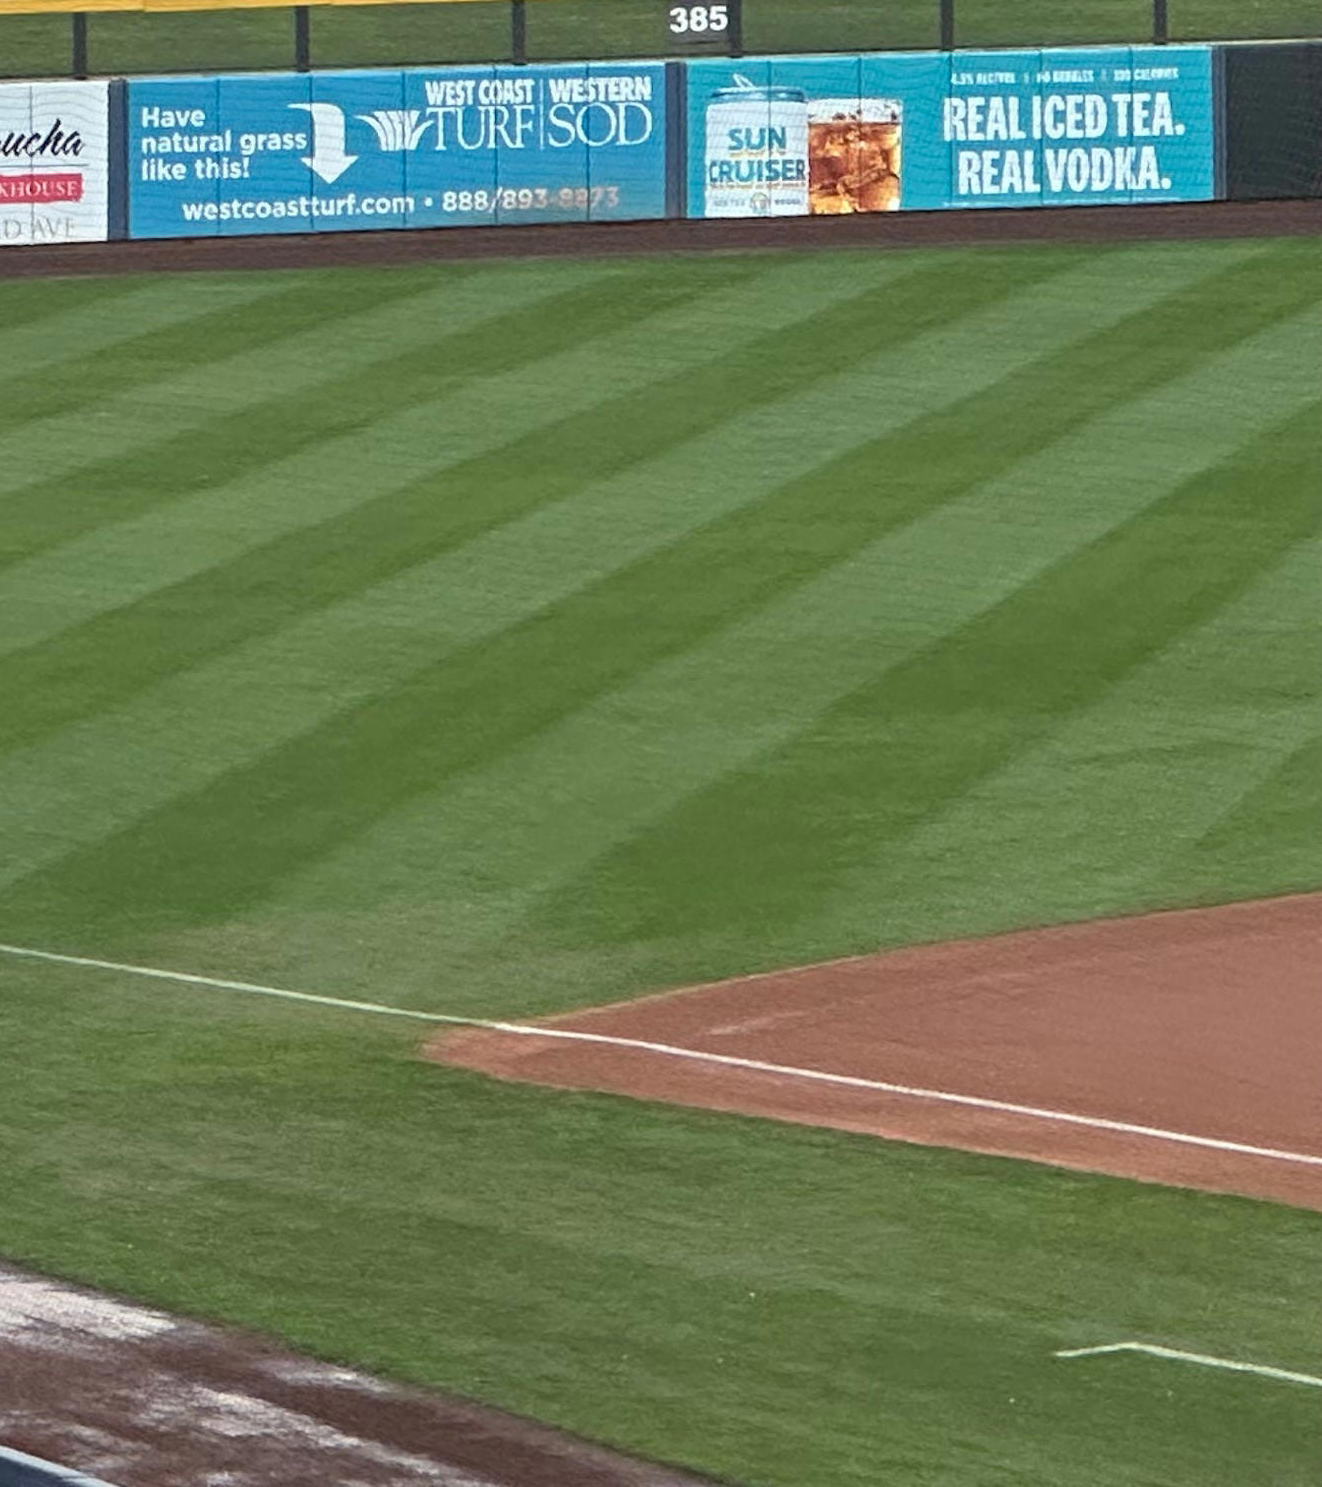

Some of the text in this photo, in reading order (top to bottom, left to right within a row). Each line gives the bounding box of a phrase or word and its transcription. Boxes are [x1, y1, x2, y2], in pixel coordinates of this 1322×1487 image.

[669, 5, 728, 33] 385
[425, 76, 652, 105] WEST COAST WESTERN
[141, 107, 206, 128] Have
[426, 102, 652, 150] TURF SOD
[943, 91, 1186, 141] REAL ICED TEA.
[141, 130, 307, 155] natural grass
[728, 126, 787, 150] SUN
[141, 157, 250, 181] like this!
[709, 159, 806, 182] CRUISER
[958, 146, 1172, 195] REAL VODKA.
[182, 193, 415, 221] westcoastturf.com
